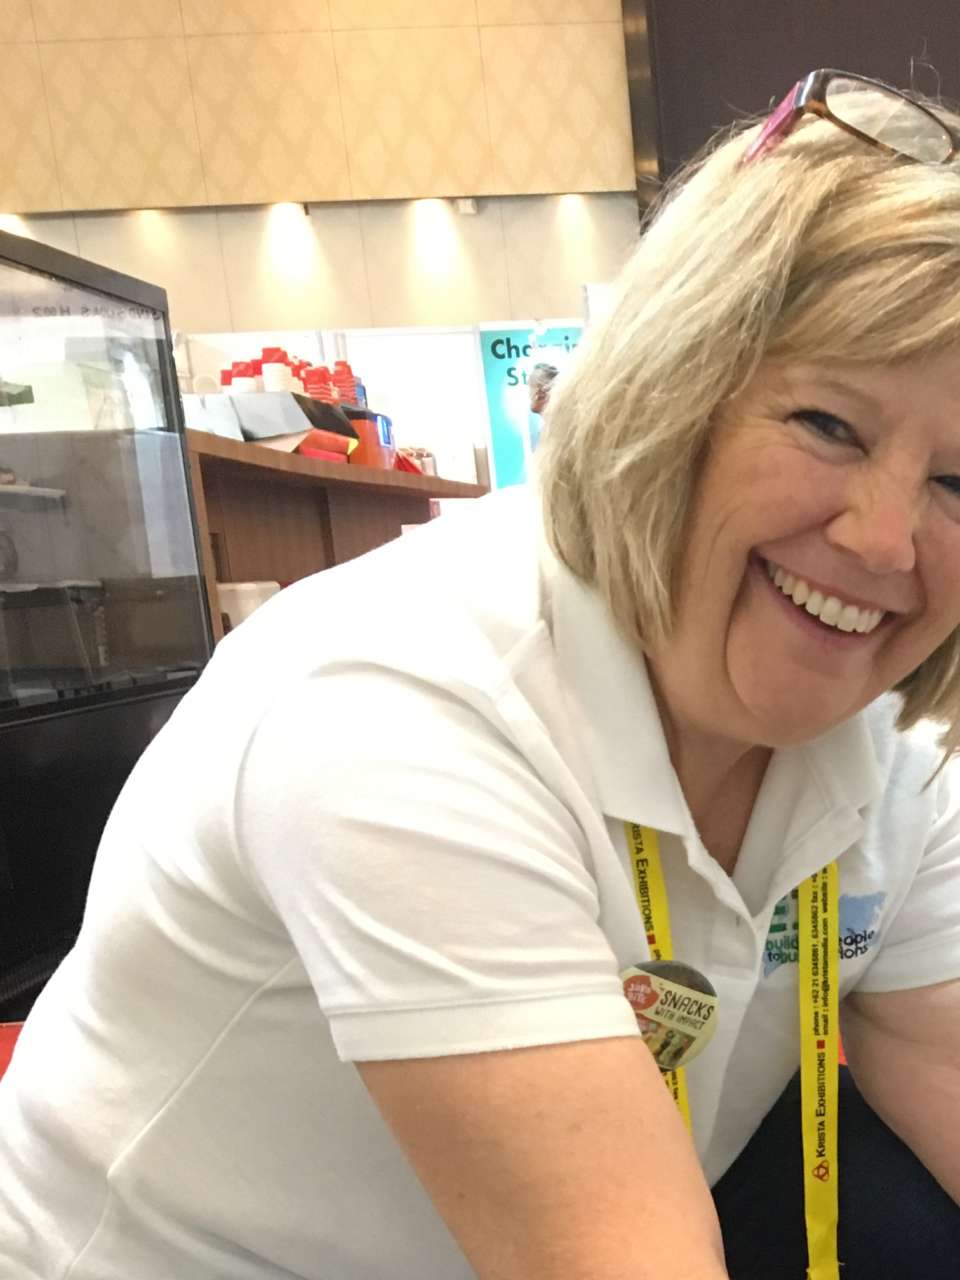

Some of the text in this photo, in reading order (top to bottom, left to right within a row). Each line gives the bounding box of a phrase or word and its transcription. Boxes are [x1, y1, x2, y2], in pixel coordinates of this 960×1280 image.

[631, 823, 655, 932] RISTA EXHIBITIONS
[654, 1005, 675, 1020] WITH
[660, 990, 715, 1021] SNACKS
